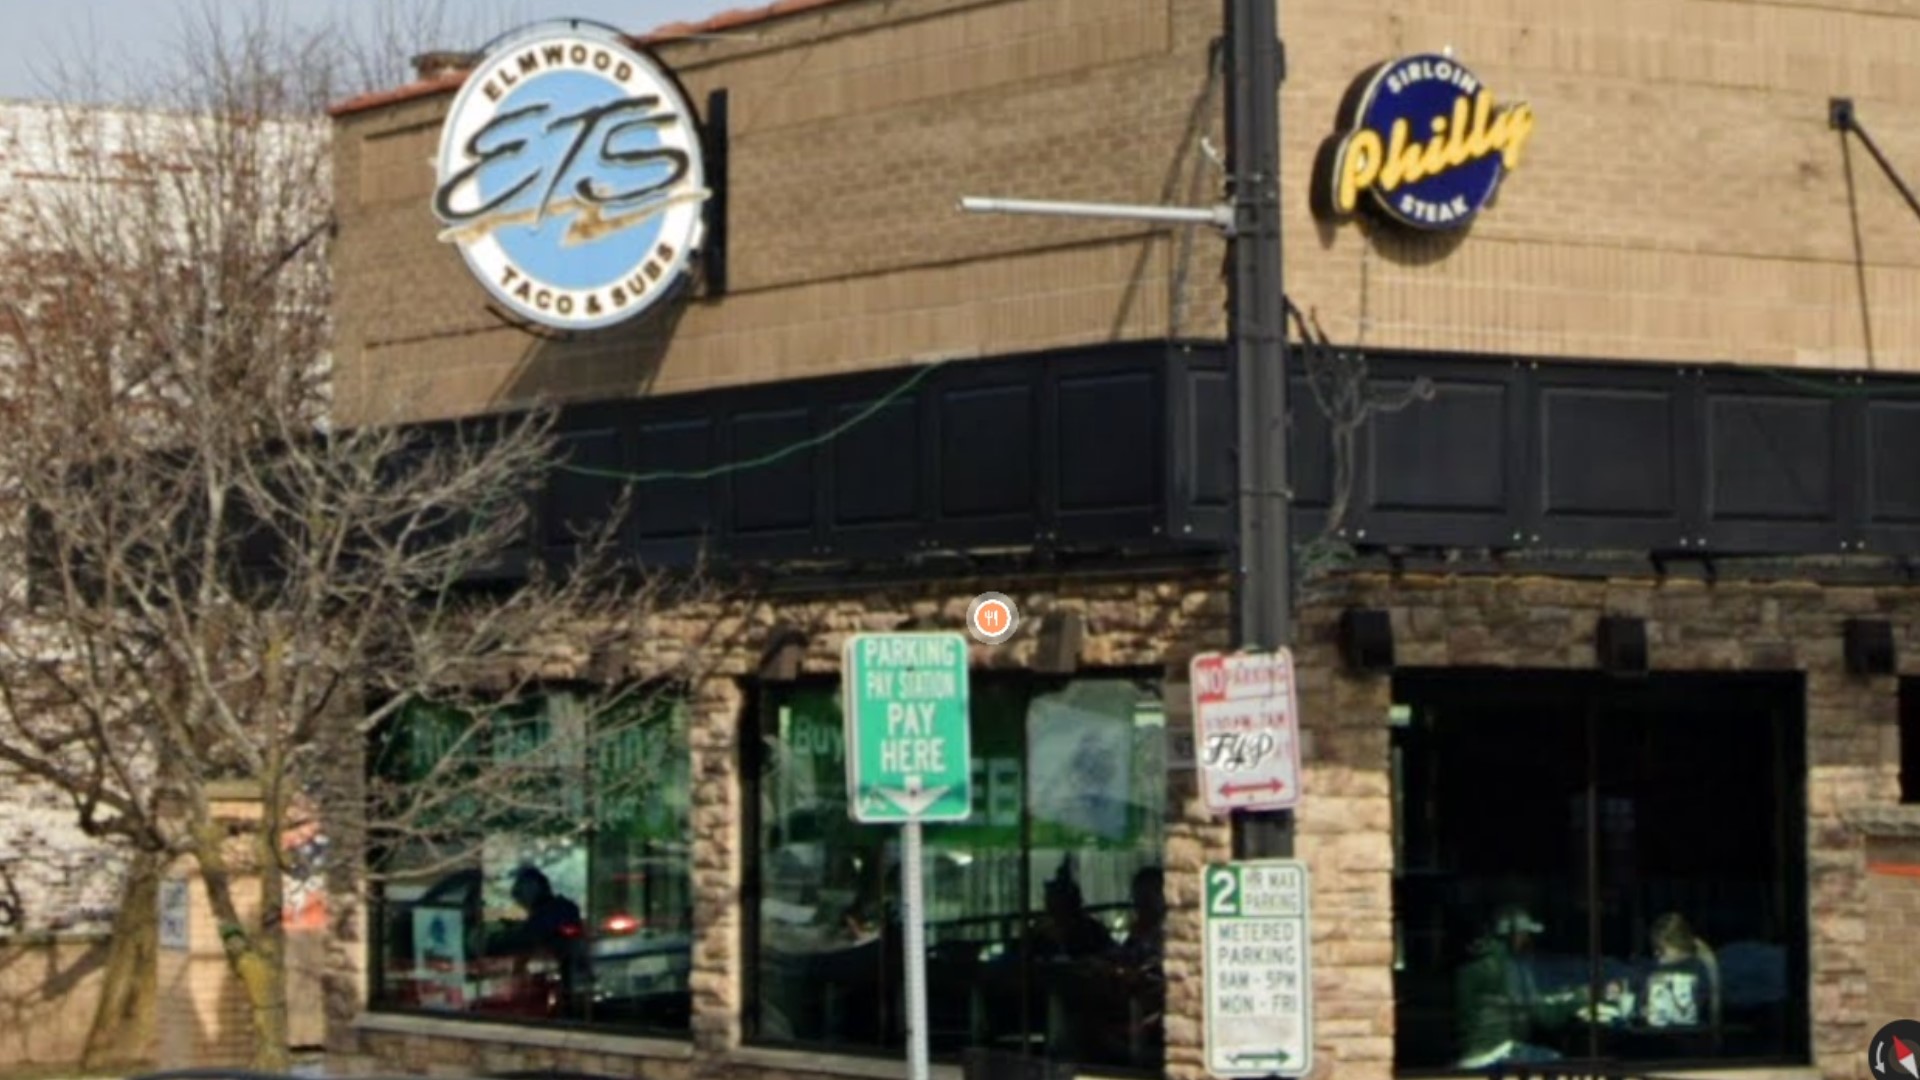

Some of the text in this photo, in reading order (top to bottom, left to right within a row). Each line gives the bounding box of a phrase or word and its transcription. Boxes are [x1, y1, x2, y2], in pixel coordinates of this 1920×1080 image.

[482, 44, 634, 102] ELMWOOD
[1387, 60, 1478, 94] SIRLOIN
[435, 95, 690, 224] ETS
[1340, 87, 1535, 211] Philly
[1399, 194, 1469, 223] STEAK
[500, 242, 675, 315] TACO & SUBS
[864, 638, 956, 667] PARKING
[865, 670, 956, 699] PAY STATION
[887, 702, 936, 738] PAY
[881, 738, 946, 773] HERE
[1210, 870, 1237, 914] 2
[1245, 871, 1296, 889] HR MAX
[1245, 894, 1297, 912] PARKING
[1218, 923, 1294, 942] METERED
[1218, 947, 1296, 966] PARKING
[1218, 972, 1249, 990] 8AM
[1266, 972, 1297, 990] 5PM
[1218, 995, 1254, 1014] MON
[1272, 994, 1297, 1013] FRI
